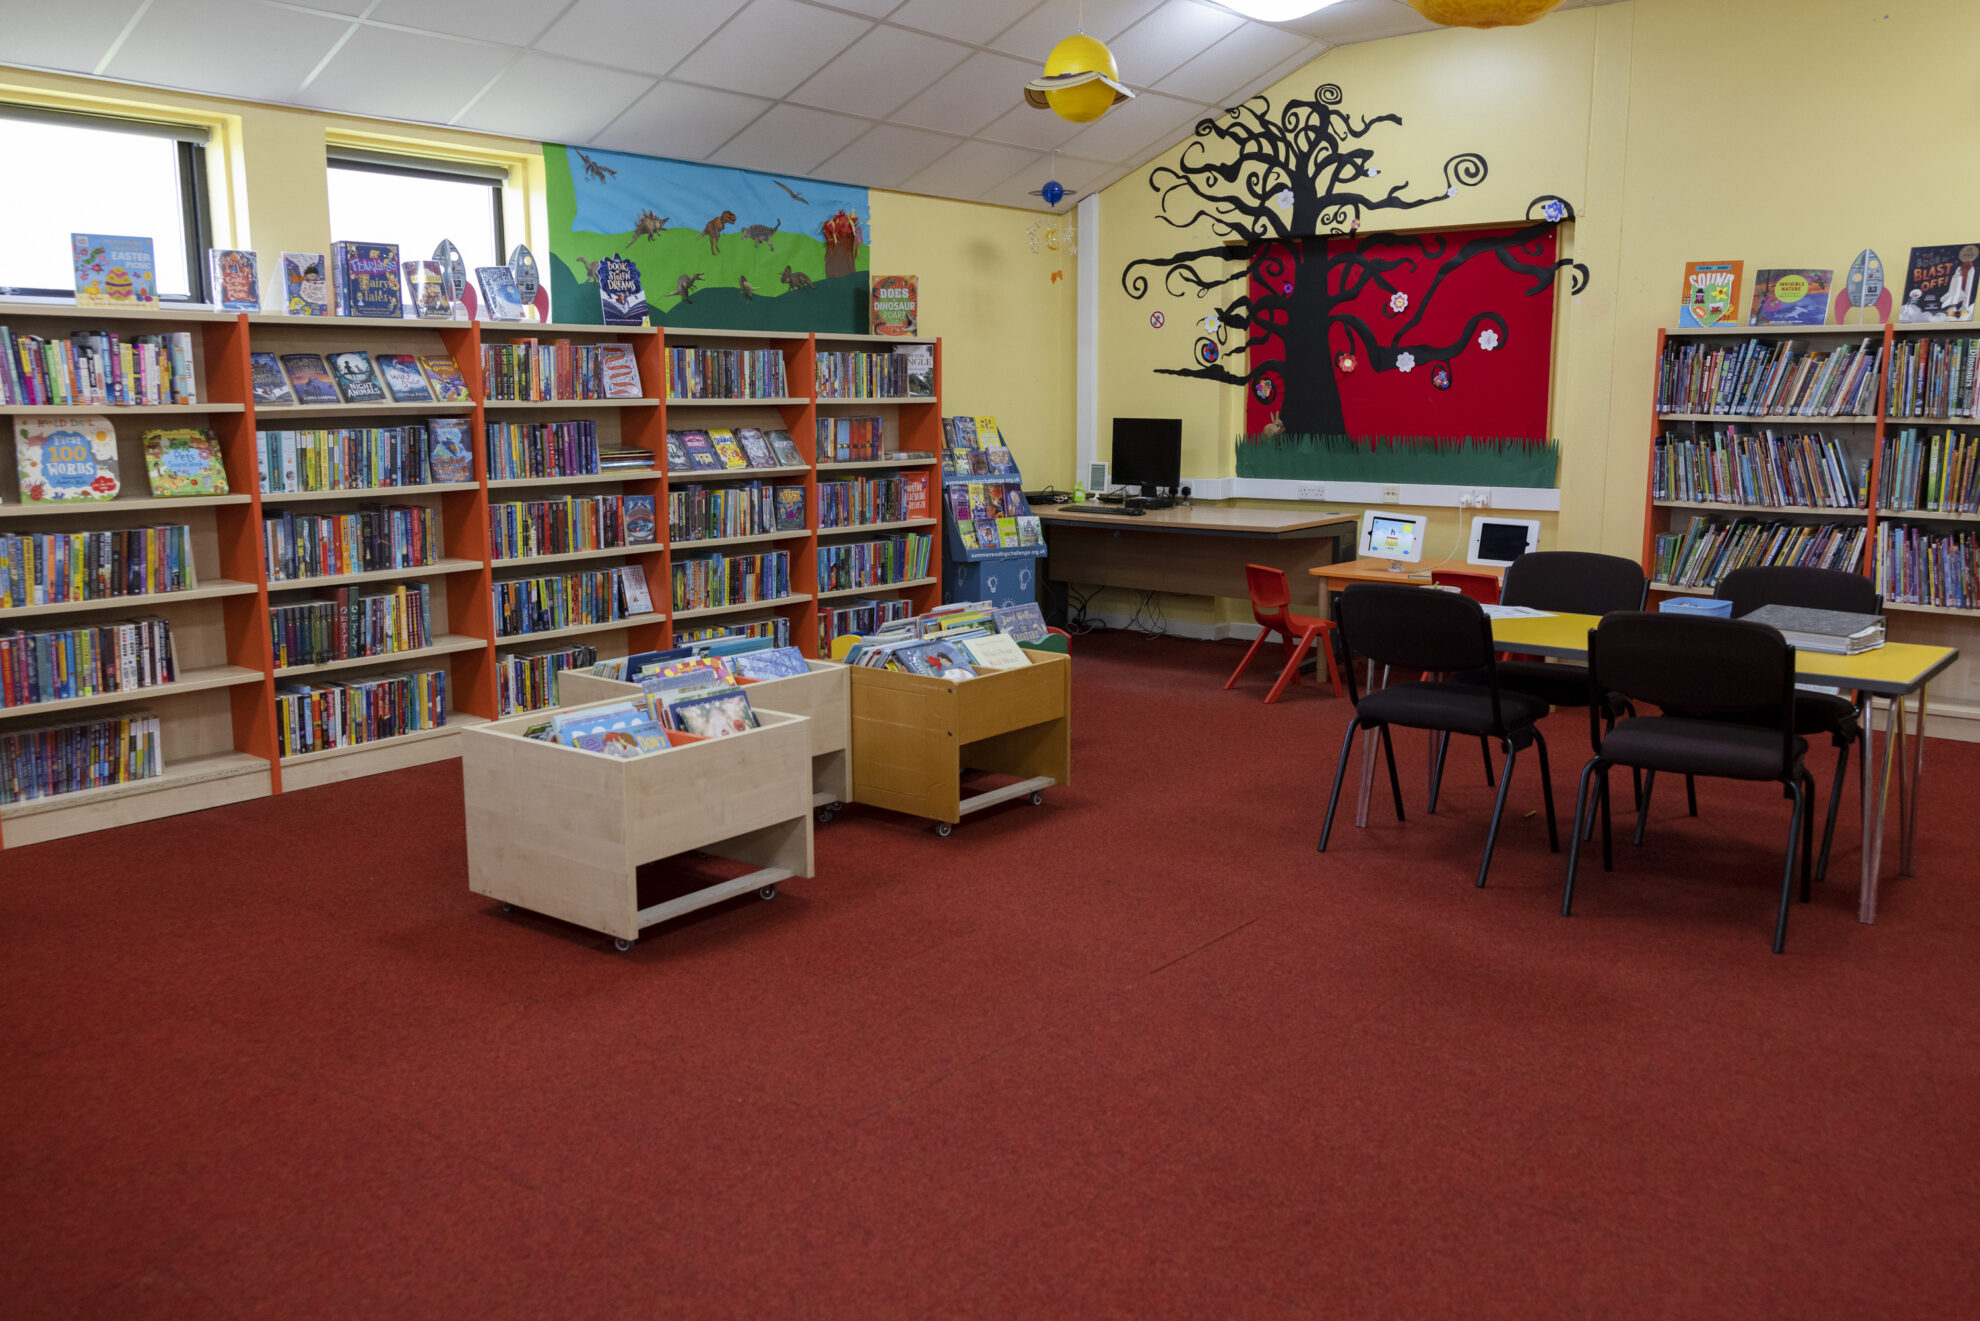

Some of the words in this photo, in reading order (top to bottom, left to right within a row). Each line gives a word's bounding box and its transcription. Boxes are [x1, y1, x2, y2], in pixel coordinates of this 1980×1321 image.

[112, 252, 150, 261] EASTER
[1914, 263, 1953, 282] BLAST
[607, 280, 636, 291] DREAMS
[1921, 275, 1949, 291] OFF!
[880, 288, 909, 298] DOES
[874, 302, 916, 310] DINOSAUR
[1965, 350, 1977, 387] Dinosaurs
[350, 382, 373, 391] NIGHT
[348, 388, 380, 398] ANIMALS
[54, 436, 82, 445] First
[48, 446, 87, 462] 100
[174, 450, 196, 461] Pets
[46, 462, 94, 475] WORDS
[637, 736, 666, 753] DON'T
